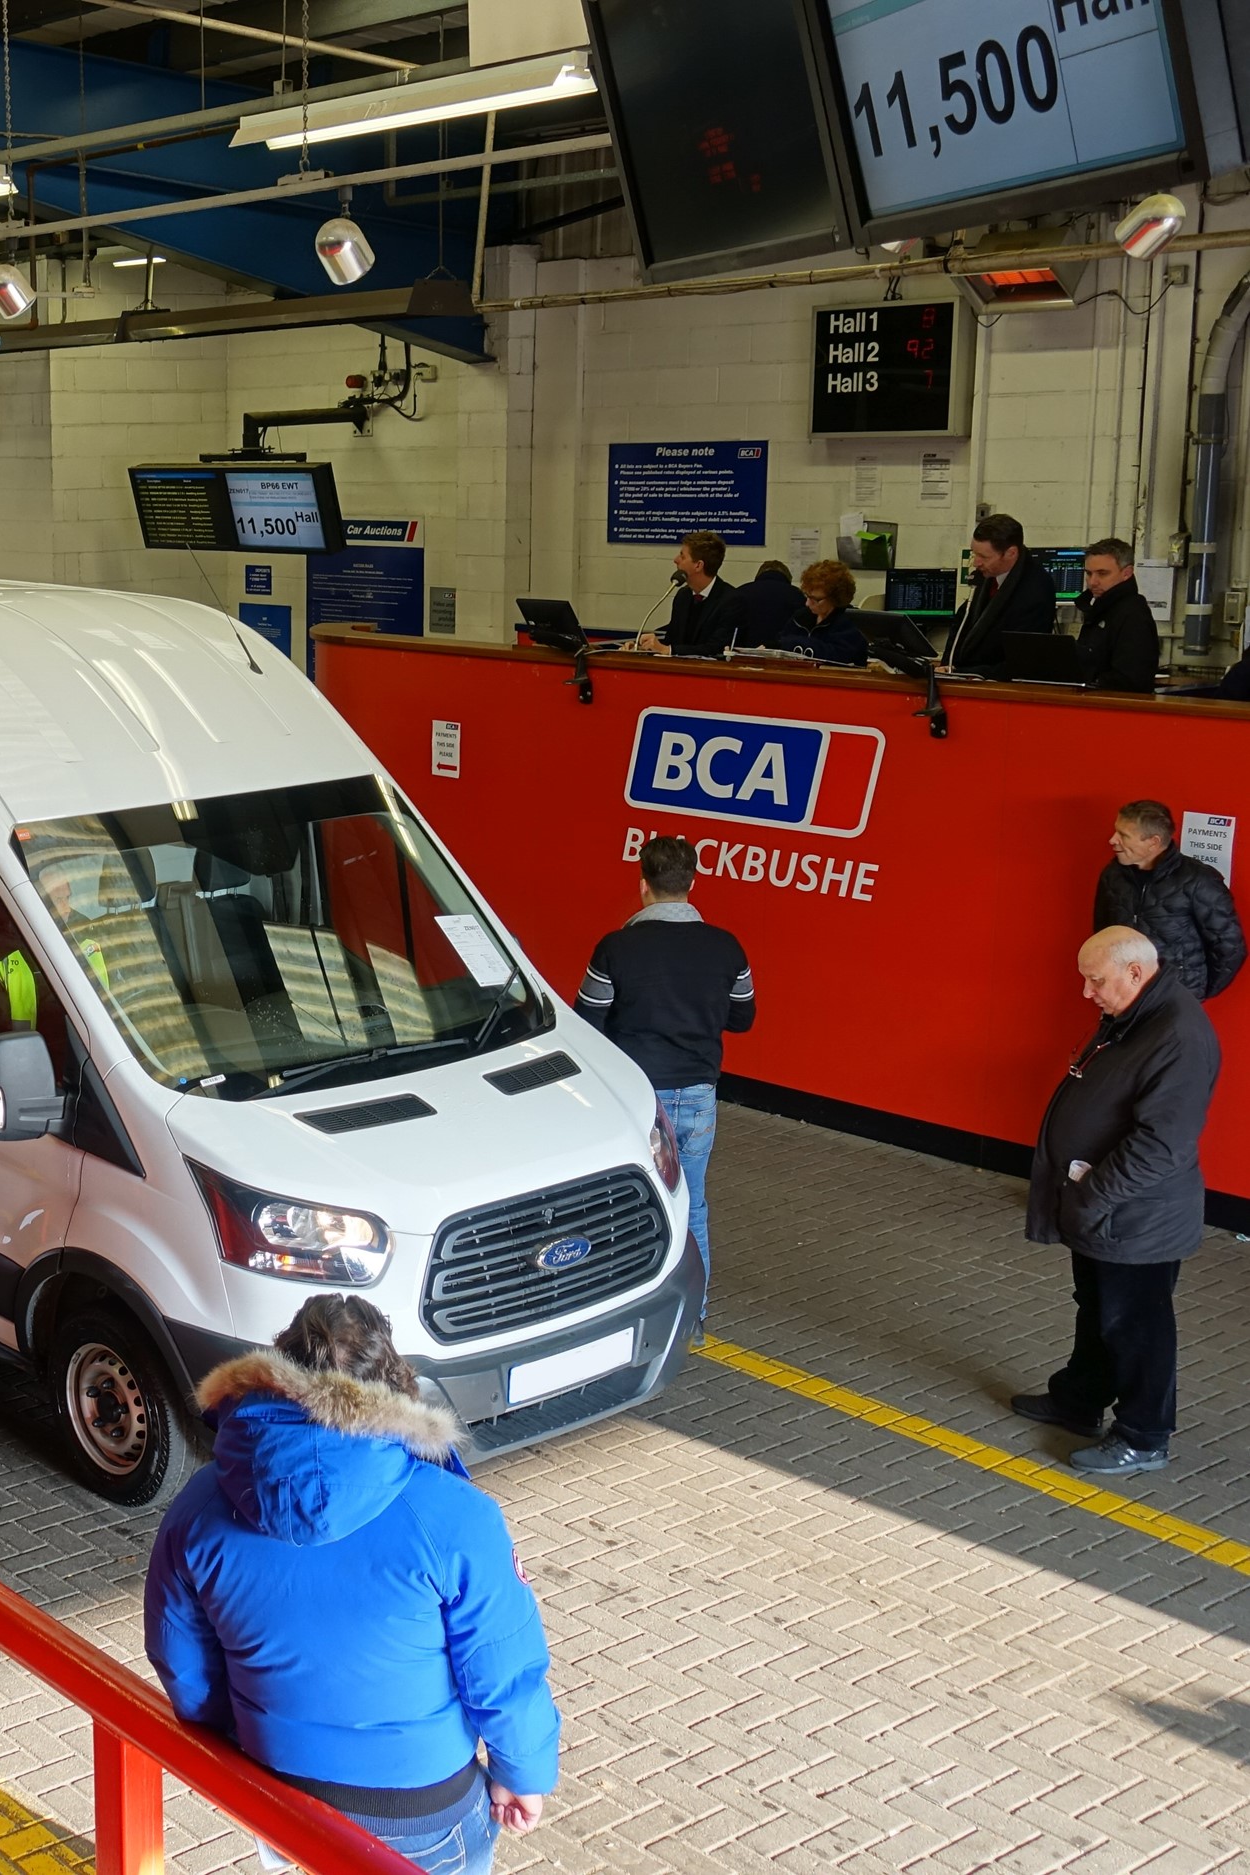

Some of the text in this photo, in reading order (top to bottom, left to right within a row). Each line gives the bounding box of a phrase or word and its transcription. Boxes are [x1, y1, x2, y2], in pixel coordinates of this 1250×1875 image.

[853, 25, 1058, 159] 11,500
[830, 312, 866, 334] Hall
[869, 312, 878, 332] 1
[829, 342, 864, 364] Hall
[866, 342, 879, 362] 2
[828, 372, 863, 393] Hall
[866, 371, 878, 391] 3
[656, 447, 715, 457] Please note
[237, 517, 297, 538] 11,500
[294, 512, 319, 523] Hall
[347, 525, 403, 536] Car Auctions
[652, 731, 788, 806] BCA
[1188, 828, 1227, 838] PAYMENTS
[1190, 841, 1222, 851] THIS SIDE
[622, 827, 880, 902] BCKBUSHE
[552, 1243, 582, 1264] Ford
